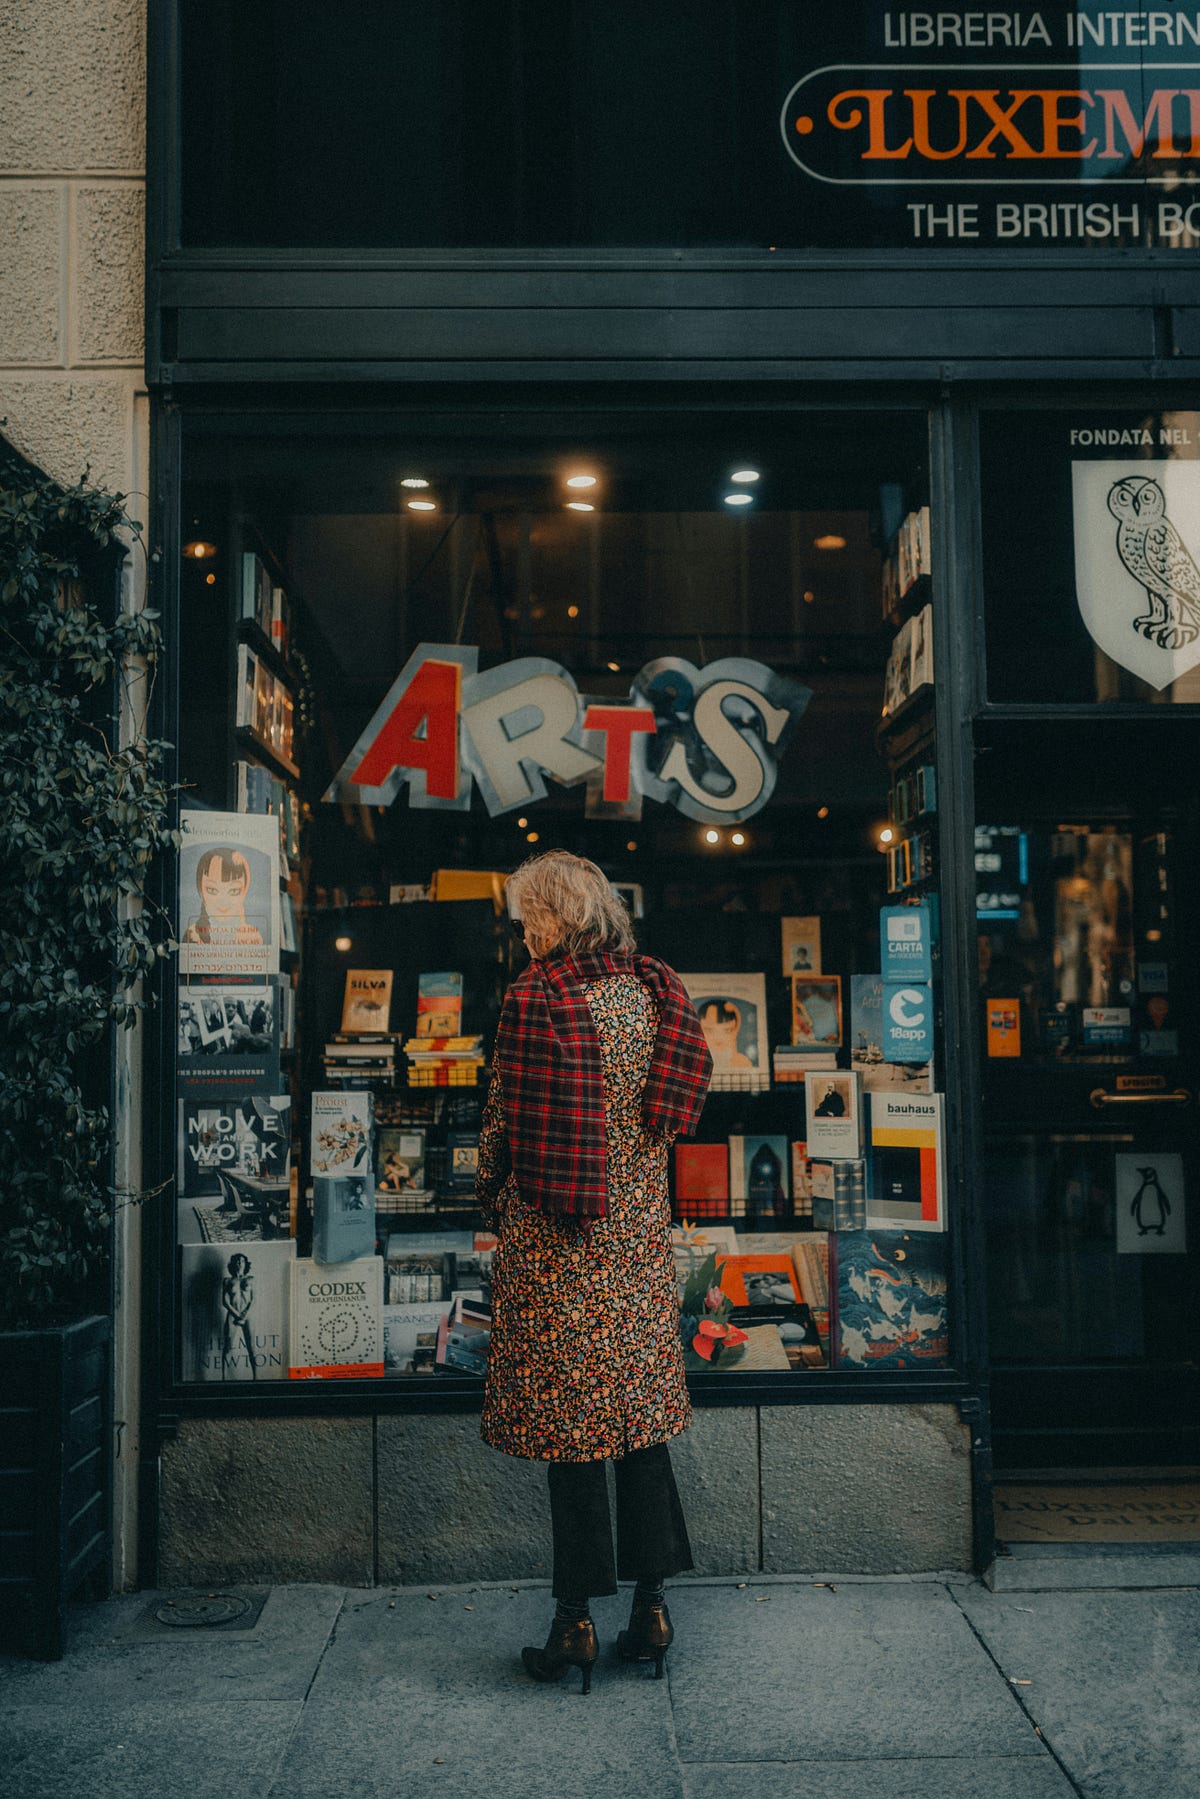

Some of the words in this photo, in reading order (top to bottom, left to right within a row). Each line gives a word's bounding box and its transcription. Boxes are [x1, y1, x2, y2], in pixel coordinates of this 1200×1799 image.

[885, 12, 1052, 47] LIBRERIA
[907, 203, 979, 238] THE
[996, 203, 1140, 238] BRITISH
[1070, 429, 1154, 445] FONDATA
[1160, 429, 1192, 445] NEL
[346, 656, 791, 813] ARTS
[888, 942, 923, 953] CARTA
[351, 979, 387, 989] SILVA
[889, 1027, 927, 1041] 18app
[315, 1096, 348, 1107] Proust
[887, 1103, 936, 1115] bauhaus
[189, 1115, 279, 1133] MOVE
[189, 1142, 279, 1161] WORK
[308, 1282, 367, 1297] CODEX
[308, 1295, 367, 1303] SERAPHINIANUS
[200, 1353, 282, 1369] NEWTON
